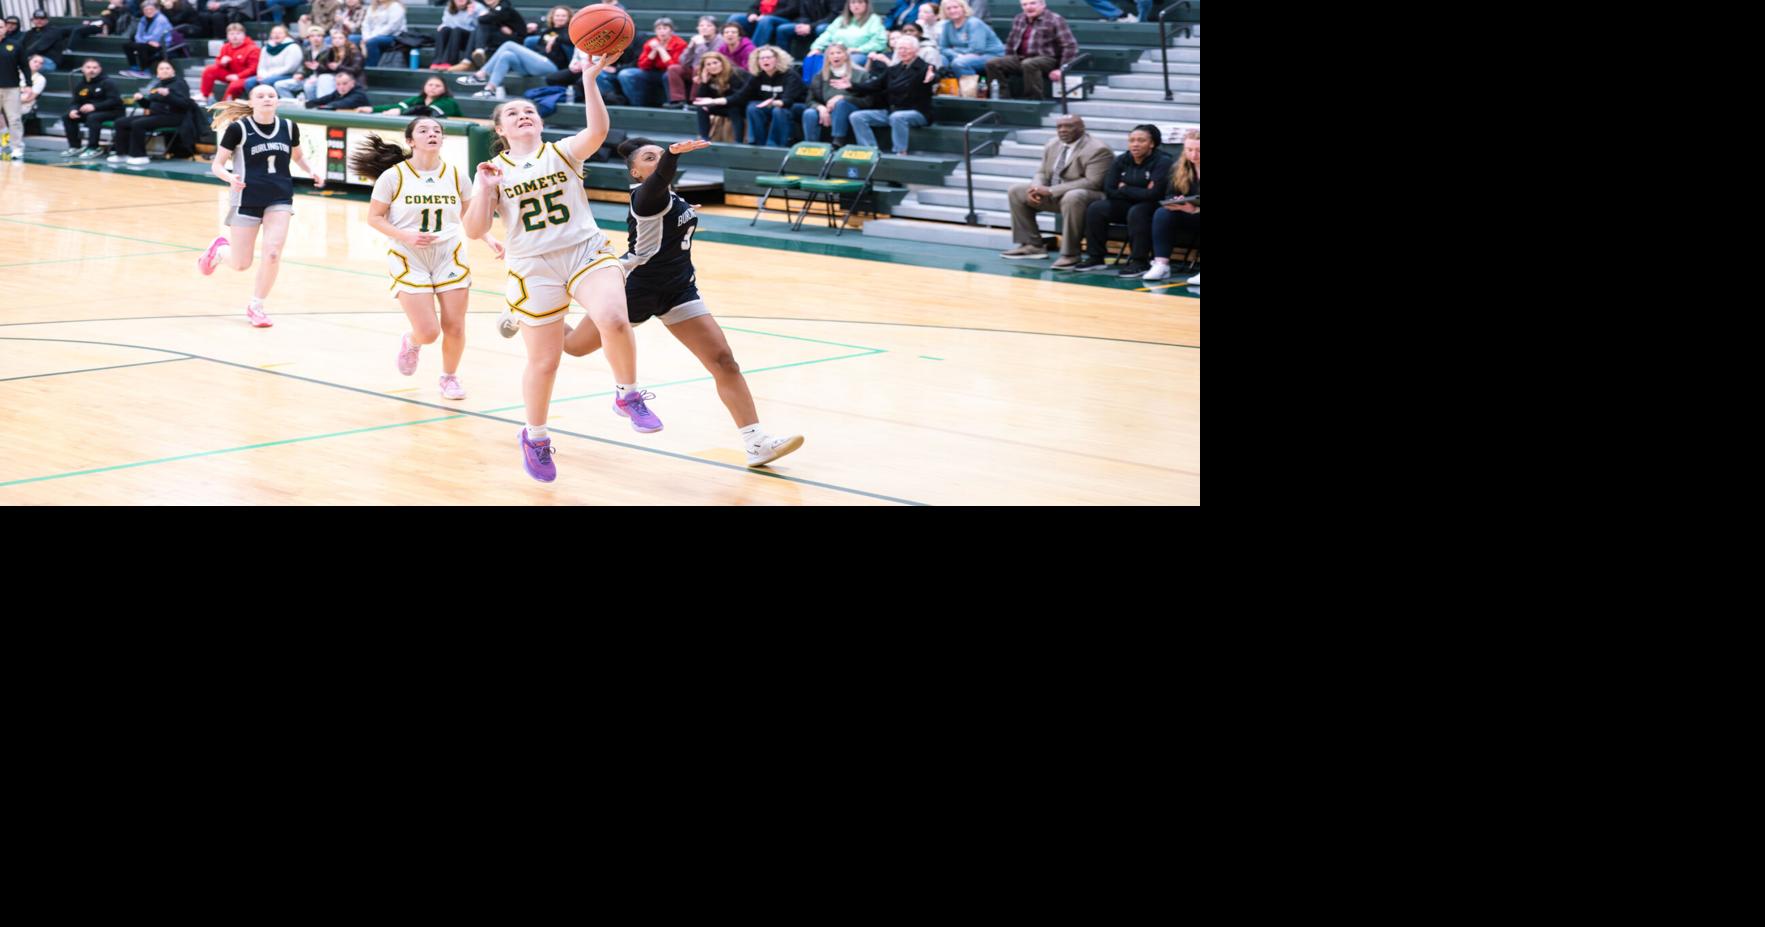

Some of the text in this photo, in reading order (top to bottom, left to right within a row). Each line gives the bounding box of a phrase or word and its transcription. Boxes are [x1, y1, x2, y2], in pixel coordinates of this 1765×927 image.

[251, 142, 290, 156] BURLINGTON
[267, 155, 277, 174] 1
[503, 171, 568, 199] COMETS
[404, 194, 457, 205] COMETS
[519, 189, 570, 232] 25
[419, 208, 443, 233] 11
